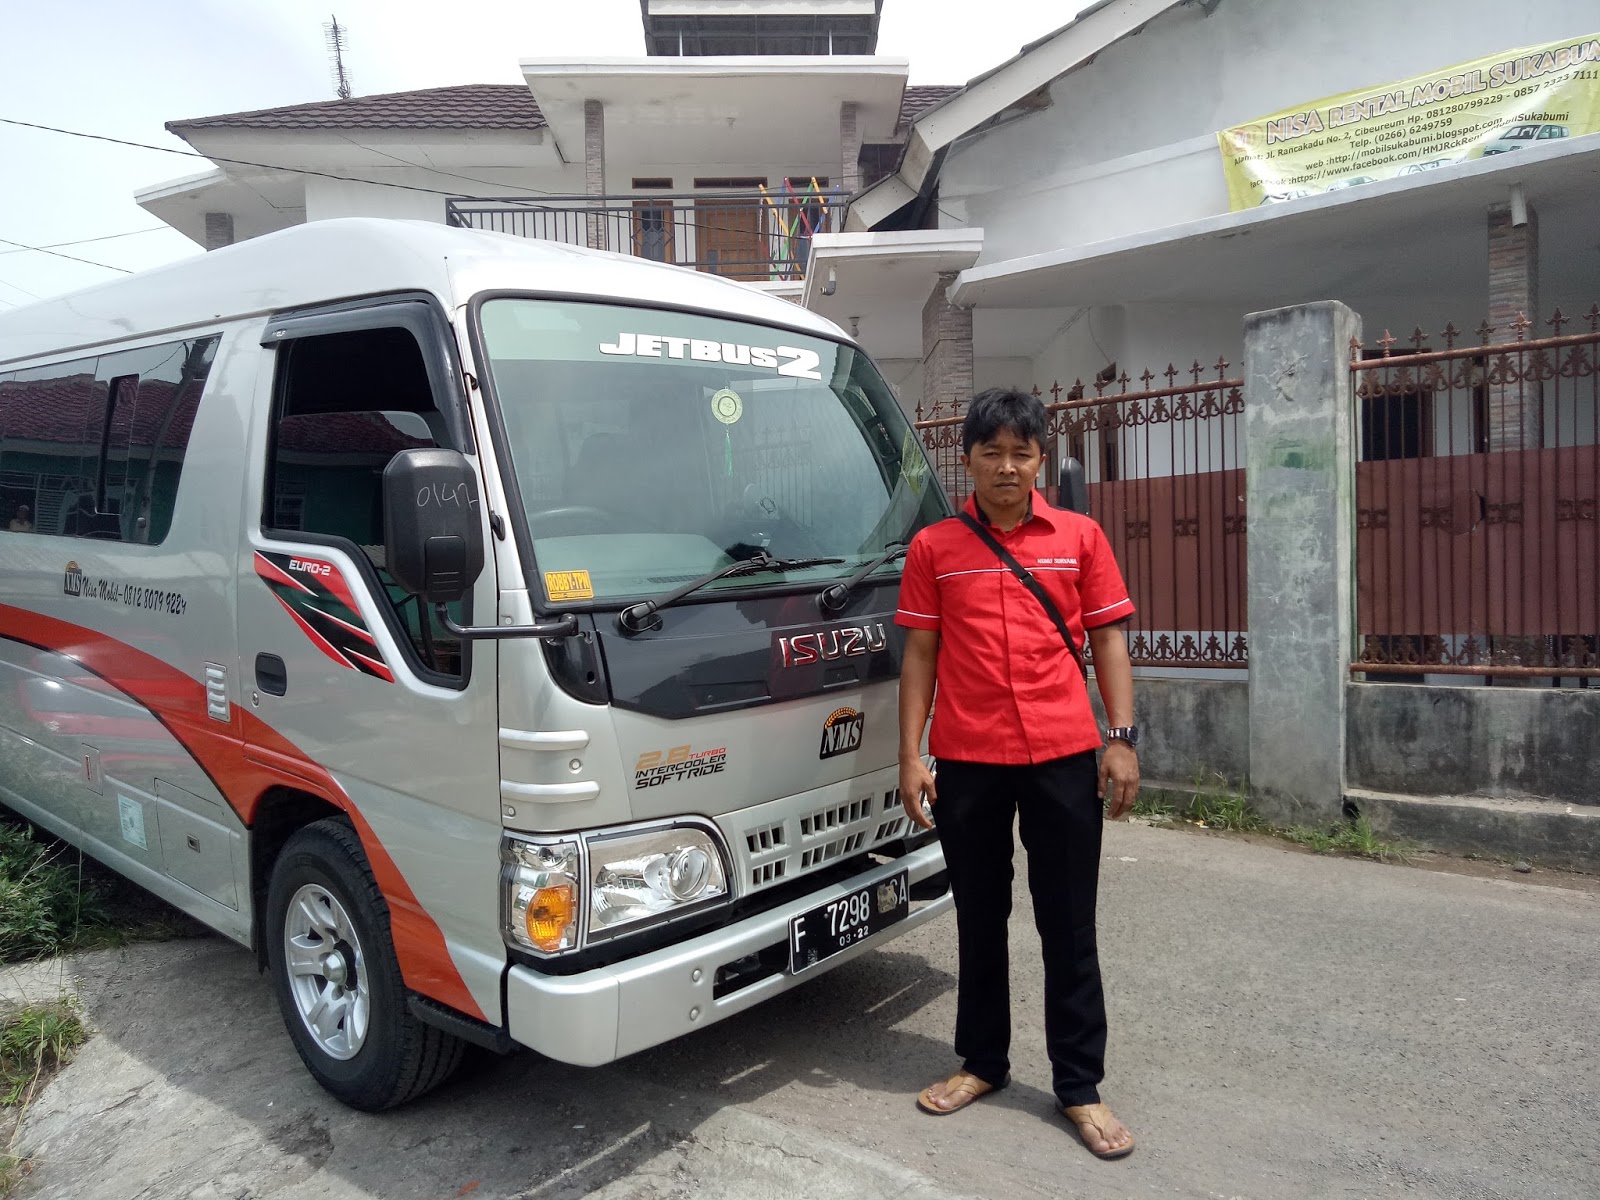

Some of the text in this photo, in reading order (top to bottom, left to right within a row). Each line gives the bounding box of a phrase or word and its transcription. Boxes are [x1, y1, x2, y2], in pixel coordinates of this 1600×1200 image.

[1234, 154, 1263, 166] Alamt:
[1265, 150, 1275, 160] Jl.
[1277, 139, 1324, 156] Rancakadu
[1326, 135, 1341, 144] No.
[1344, 131, 1352, 140] 2,
[1354, 119, 1404, 137] Cibeureum
[1407, 115, 1423, 125] Hp.
[1426, 94, 1503, 119] 081280799229
[1513, 84, 1540, 98] 0857
[1572, 70, 1599, 80] 7111
[1267, 109, 1324, 145] NISA
[1329, 90, 1409, 129] RENTAL
[1411, 69, 1488, 108] MOBIL
[1349, 117, 1453, 149] Telp. (0266) 6249759
[1305, 160, 1324, 170] web
[599, 332, 822, 381] JETBUS2
[288, 559, 331, 576] EURO-2
[82, 575, 97, 598] Nisa
[143, 588, 164, 612] 8079
[779, 623, 887, 668] ISUZU
[821, 718, 864, 755] NMS
[635, 744, 727, 770] 2.8 TURBO
[635, 753, 727, 779] INTERCOOLER
[794, 916, 806, 953] F
[827, 890, 870, 936] 7298
